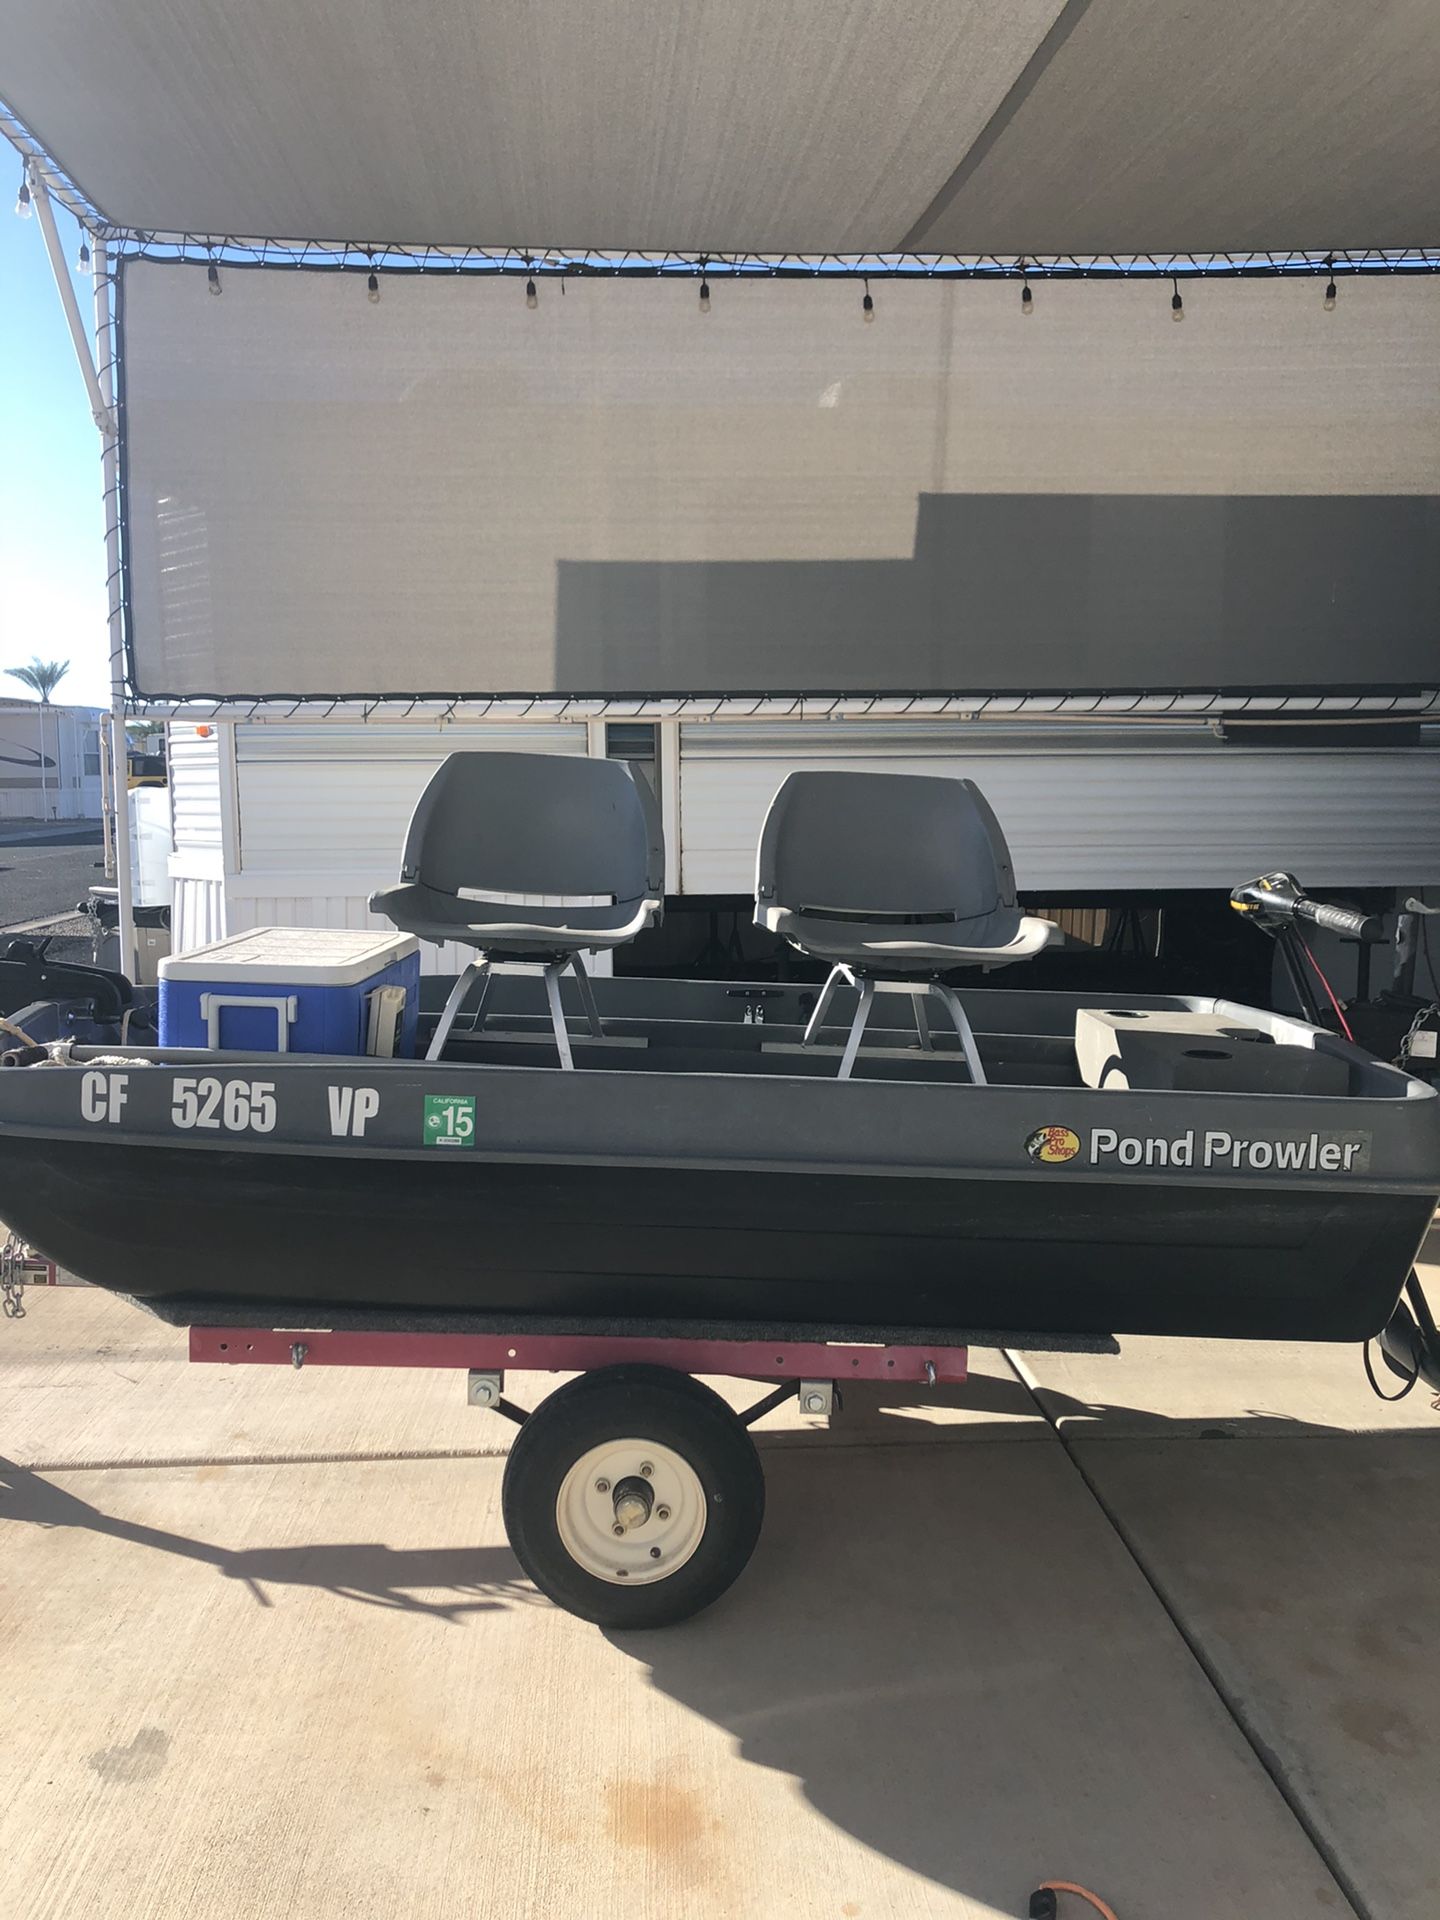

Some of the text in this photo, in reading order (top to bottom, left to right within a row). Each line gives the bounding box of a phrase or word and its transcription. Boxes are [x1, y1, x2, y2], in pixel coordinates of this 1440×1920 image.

[80, 1071, 380, 1137] CF 5265 VP
[432, 1097, 469, 1105] CALIFORNIA
[442, 1105, 474, 1137] 15
[1048, 1127, 1068, 1137] Bass
[1047, 1145, 1077, 1157] Shops
[1089, 1127, 1361, 1171] Pond Prowler
